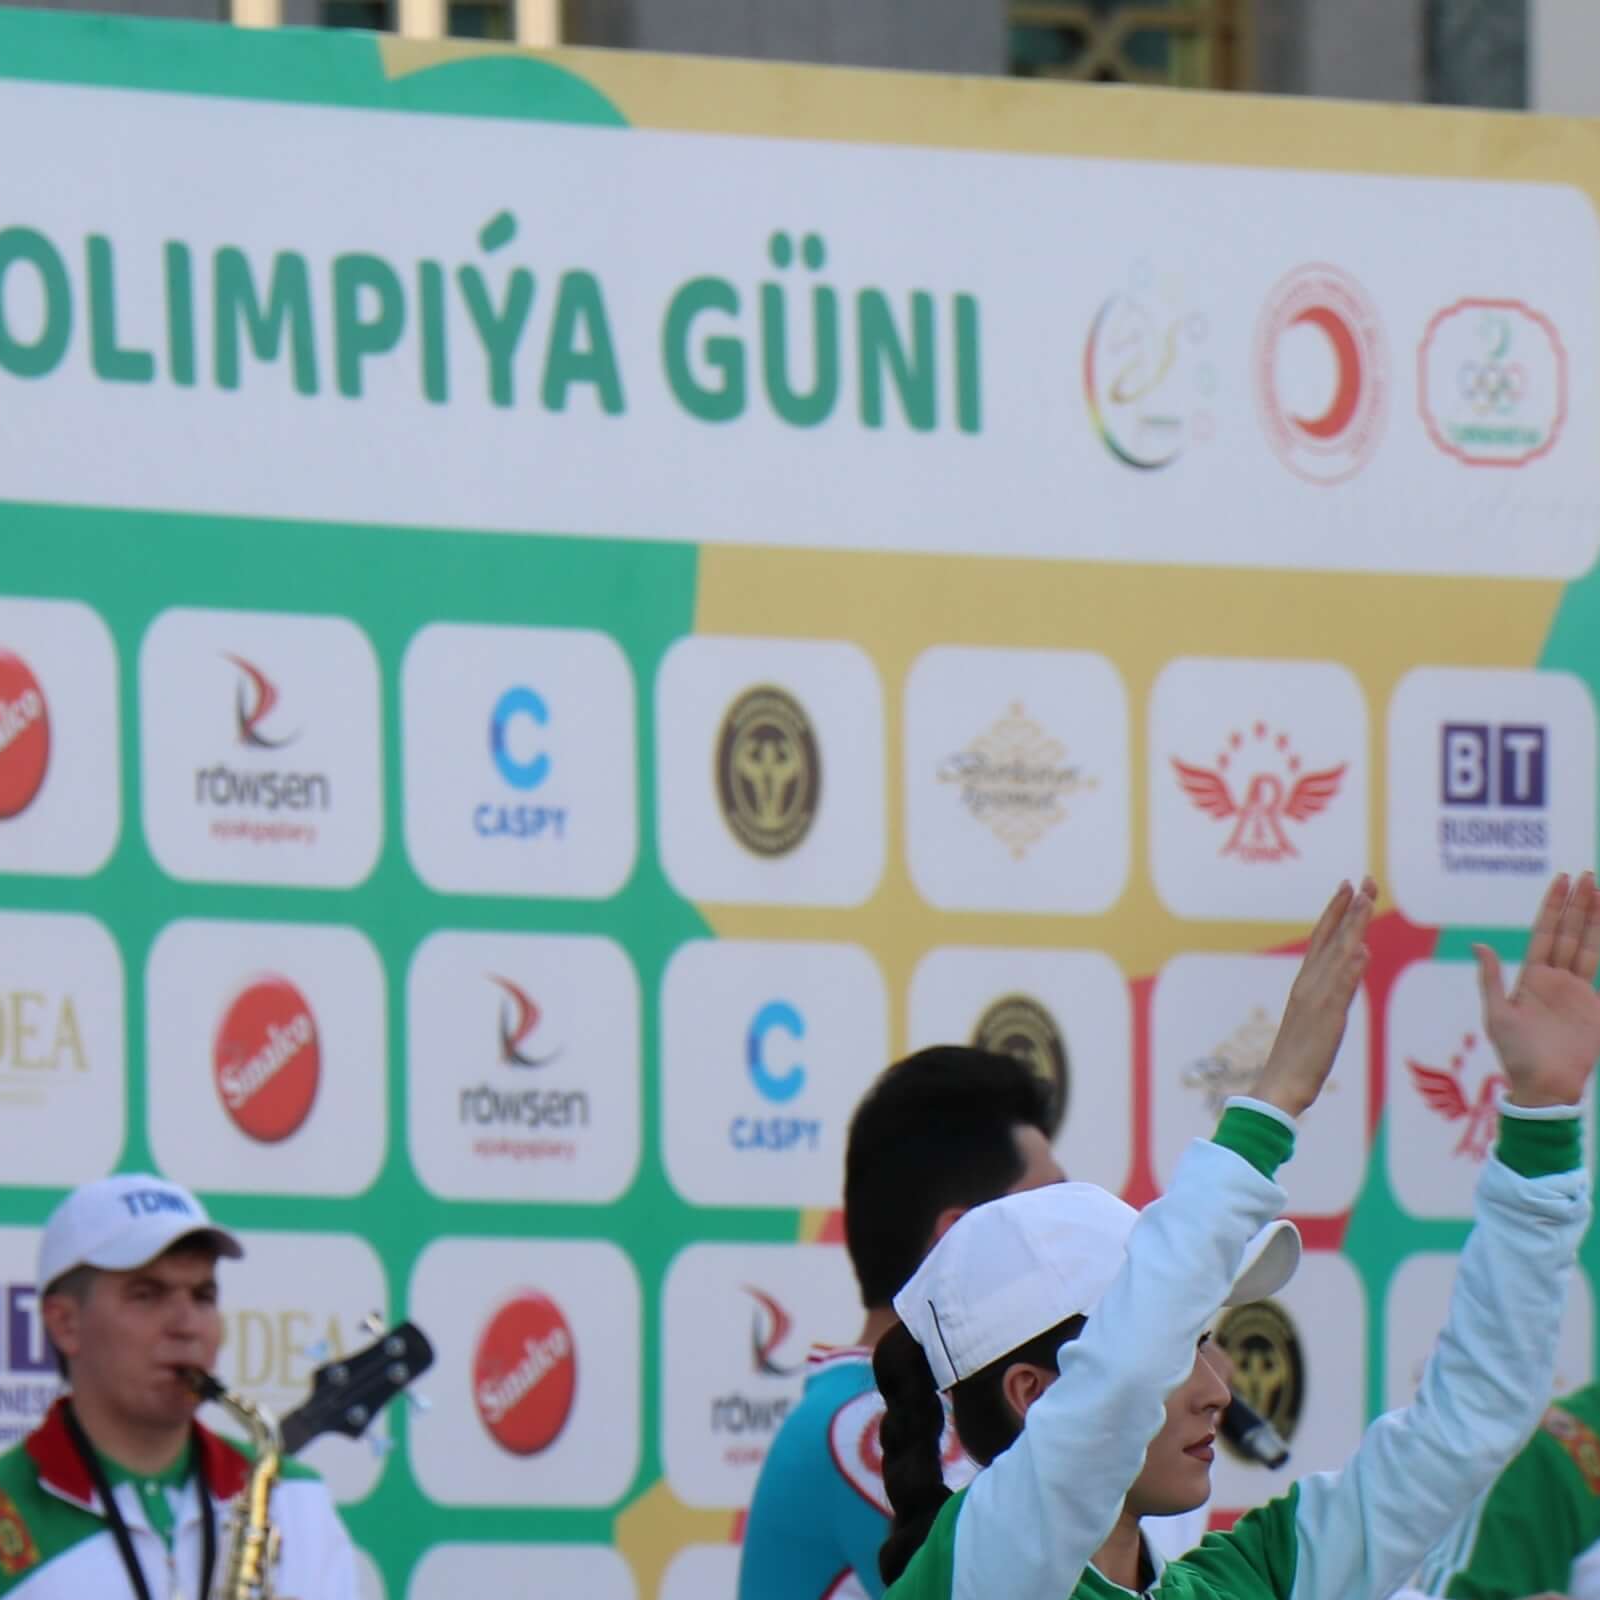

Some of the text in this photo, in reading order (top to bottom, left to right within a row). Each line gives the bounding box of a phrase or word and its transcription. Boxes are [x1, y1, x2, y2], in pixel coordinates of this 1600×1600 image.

[661, 230, 982, 436] GÜNI
[473, 804, 567, 840] CASPY
[1438, 816, 1547, 847] BUSINESS
[730, 1116, 822, 1152] CASPY
